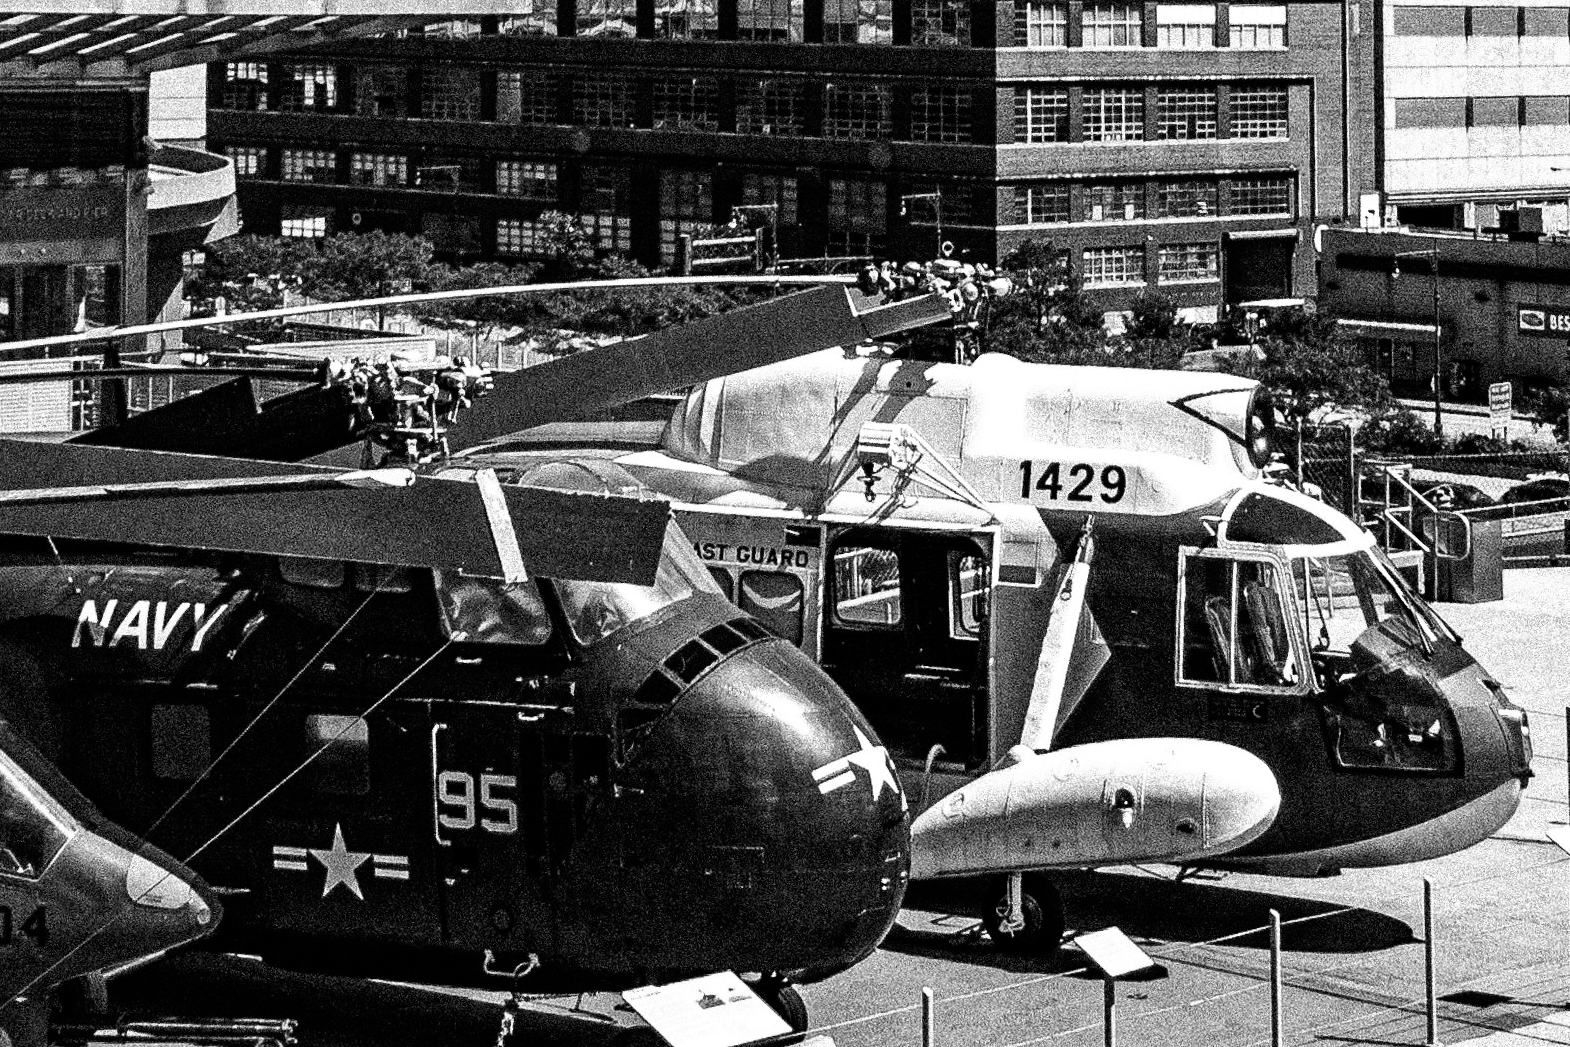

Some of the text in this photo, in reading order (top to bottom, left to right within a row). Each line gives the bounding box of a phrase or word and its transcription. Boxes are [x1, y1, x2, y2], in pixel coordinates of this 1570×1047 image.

[1019, 459, 1127, 505] 1429
[736, 544, 809, 568] GUARD
[71, 598, 229, 652] NAVY
[438, 770, 518, 833] 95
